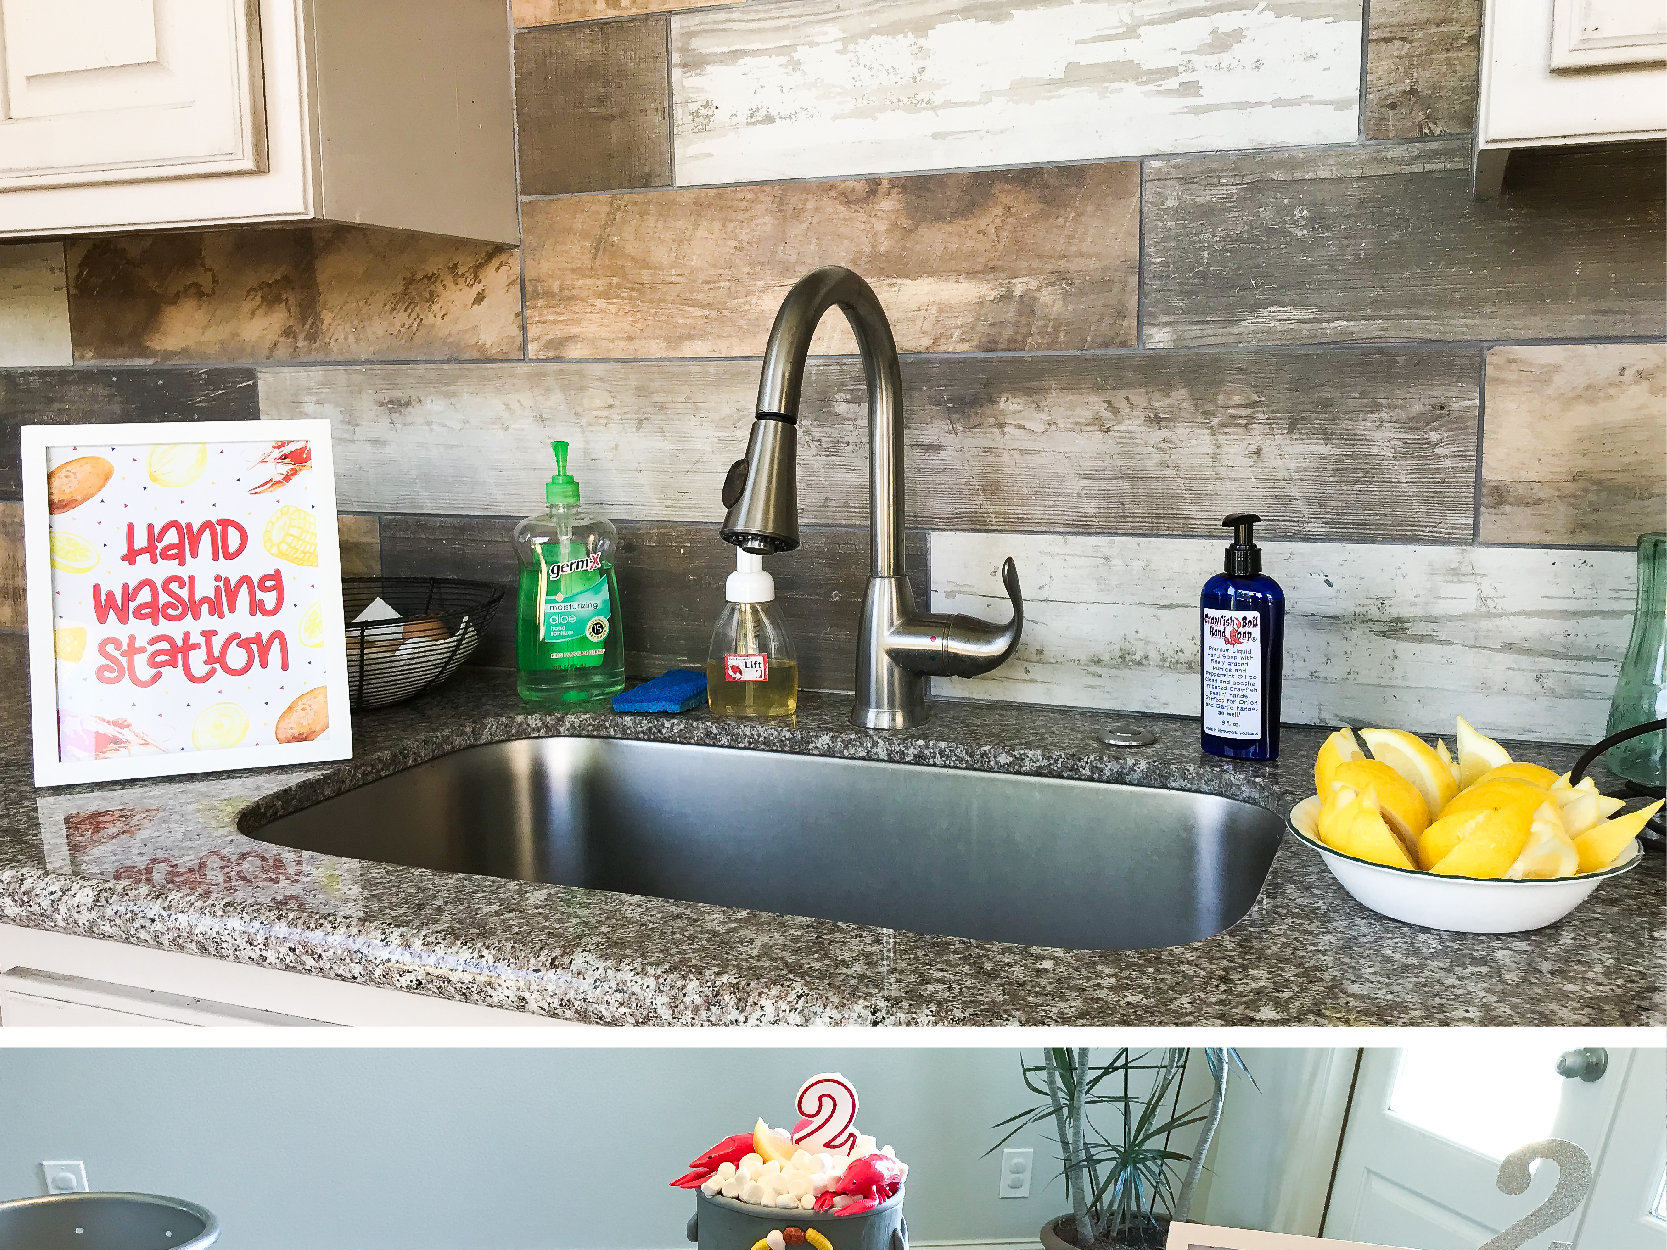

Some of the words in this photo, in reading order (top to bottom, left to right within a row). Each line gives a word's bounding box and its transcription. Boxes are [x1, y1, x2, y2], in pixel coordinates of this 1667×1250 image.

[550, 613, 577, 624] aloe
[1242, 615, 1258, 628] Boil
[1209, 625, 1226, 638] Hand
[744, 660, 762, 669] Lift
[794, 1072, 859, 1157] 2
